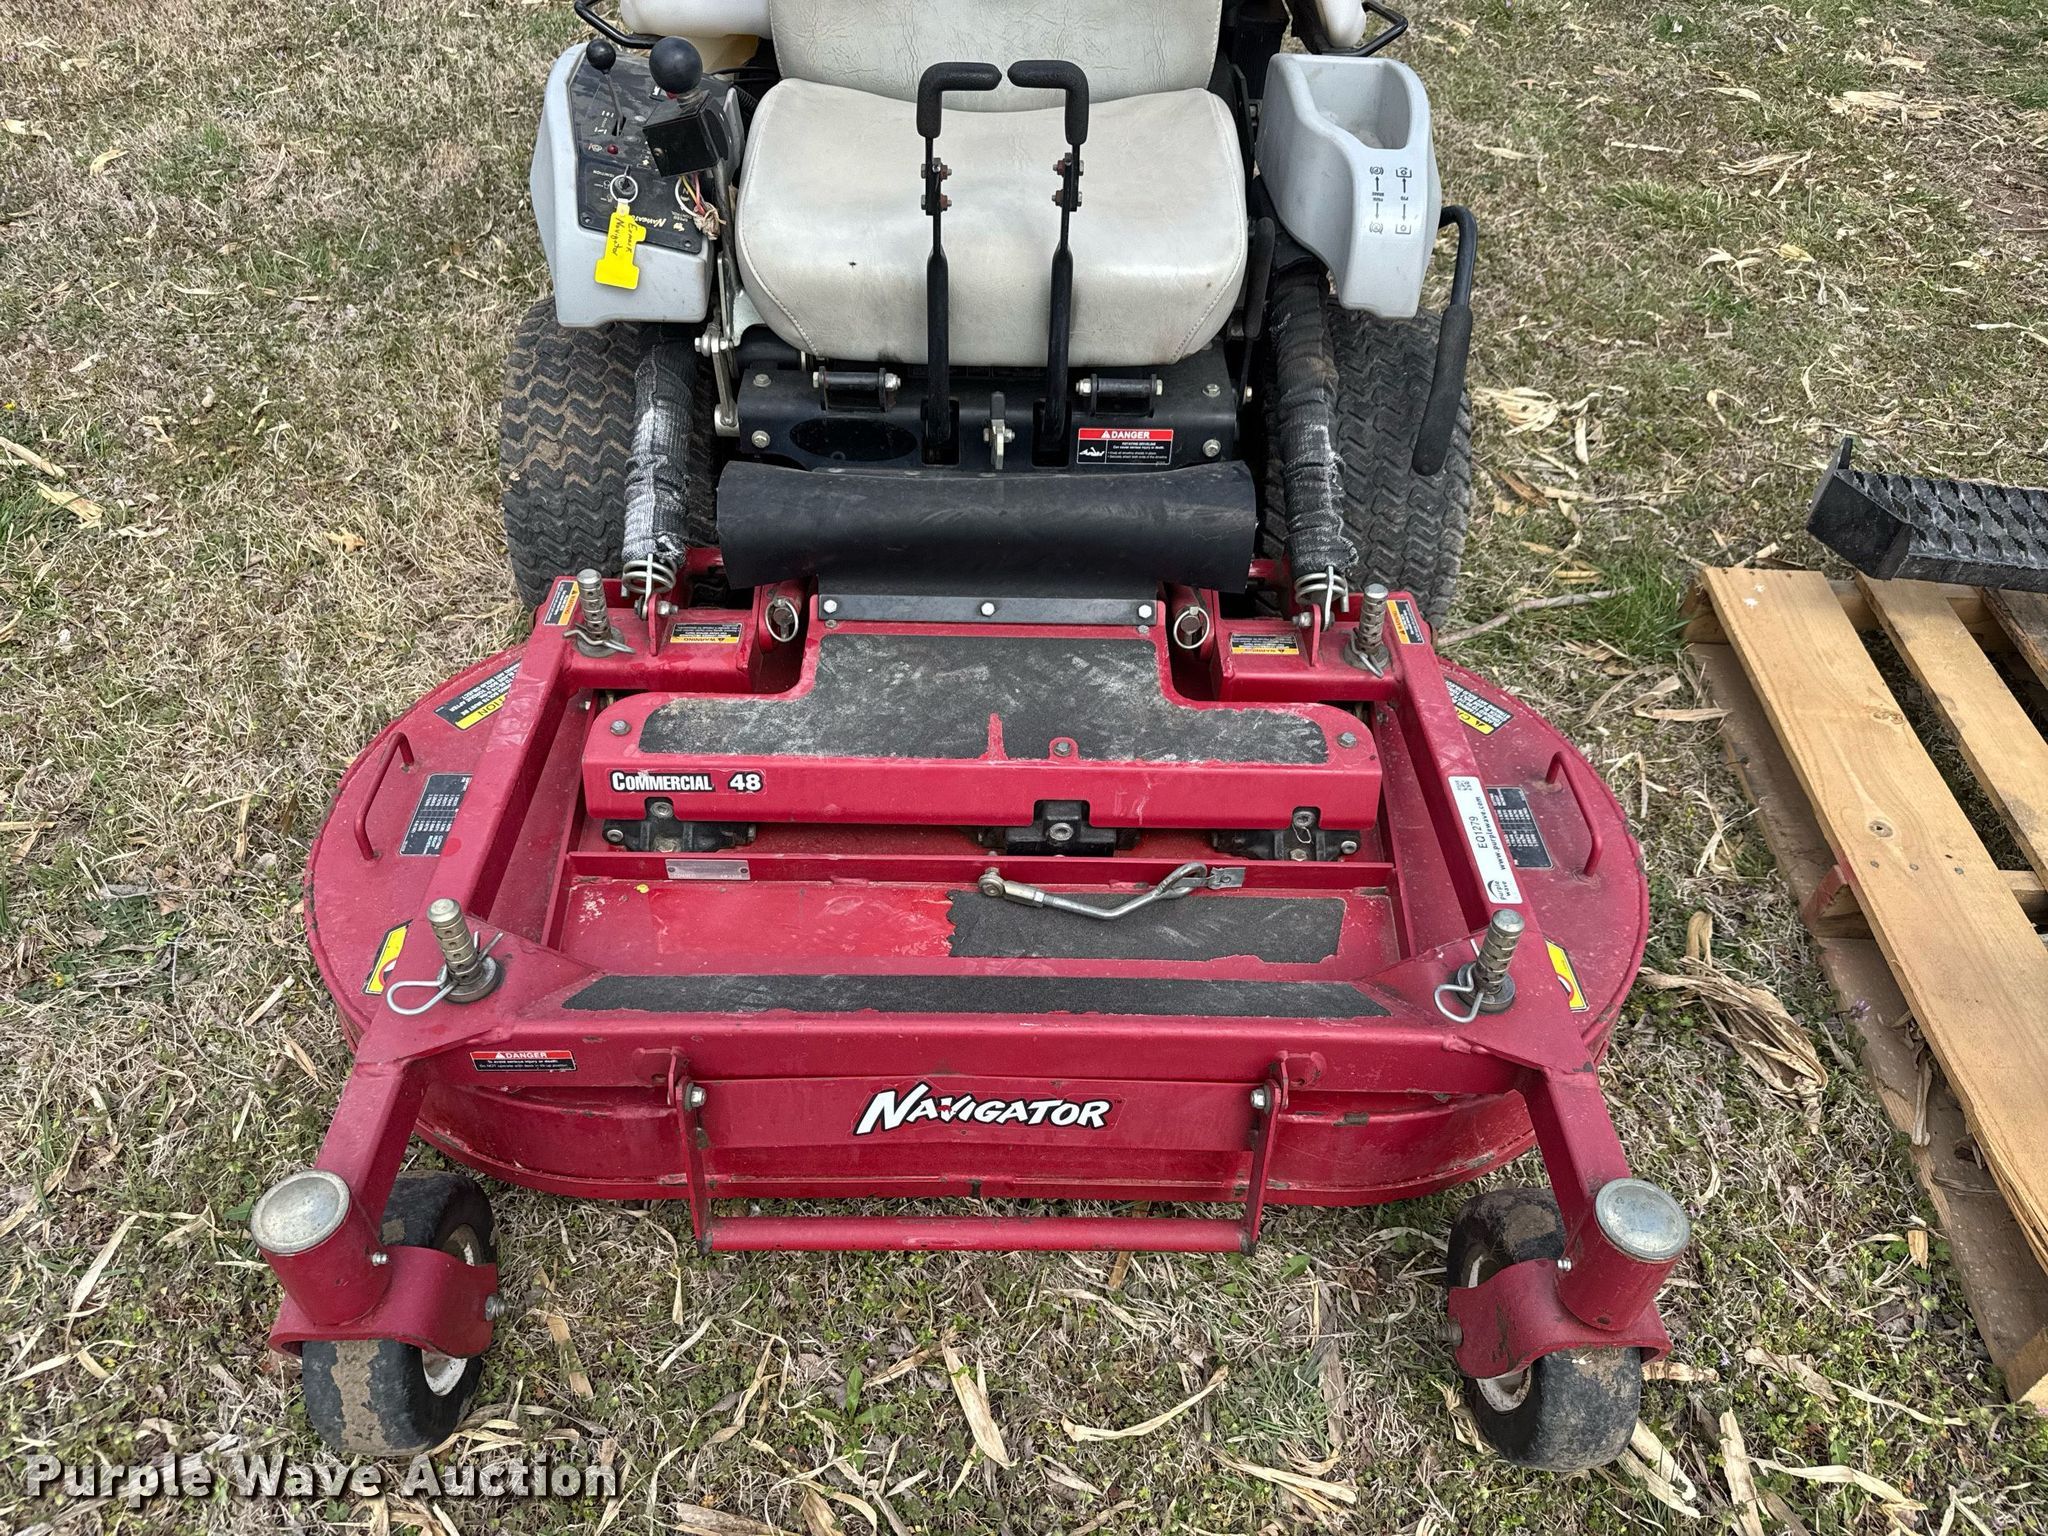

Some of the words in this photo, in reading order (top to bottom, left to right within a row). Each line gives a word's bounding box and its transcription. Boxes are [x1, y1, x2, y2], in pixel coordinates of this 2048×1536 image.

[612, 772, 713, 790] COMMERCIAL
[730, 774, 761, 791] 48
[1469, 816, 1488, 849] EQ1279
[1475, 796, 1506, 870] www.purplewave.com
[1494, 881, 1506, 900] purple
[1502, 881, 1510, 897] wave
[856, 1083, 1110, 1134] NAVIGATOR
